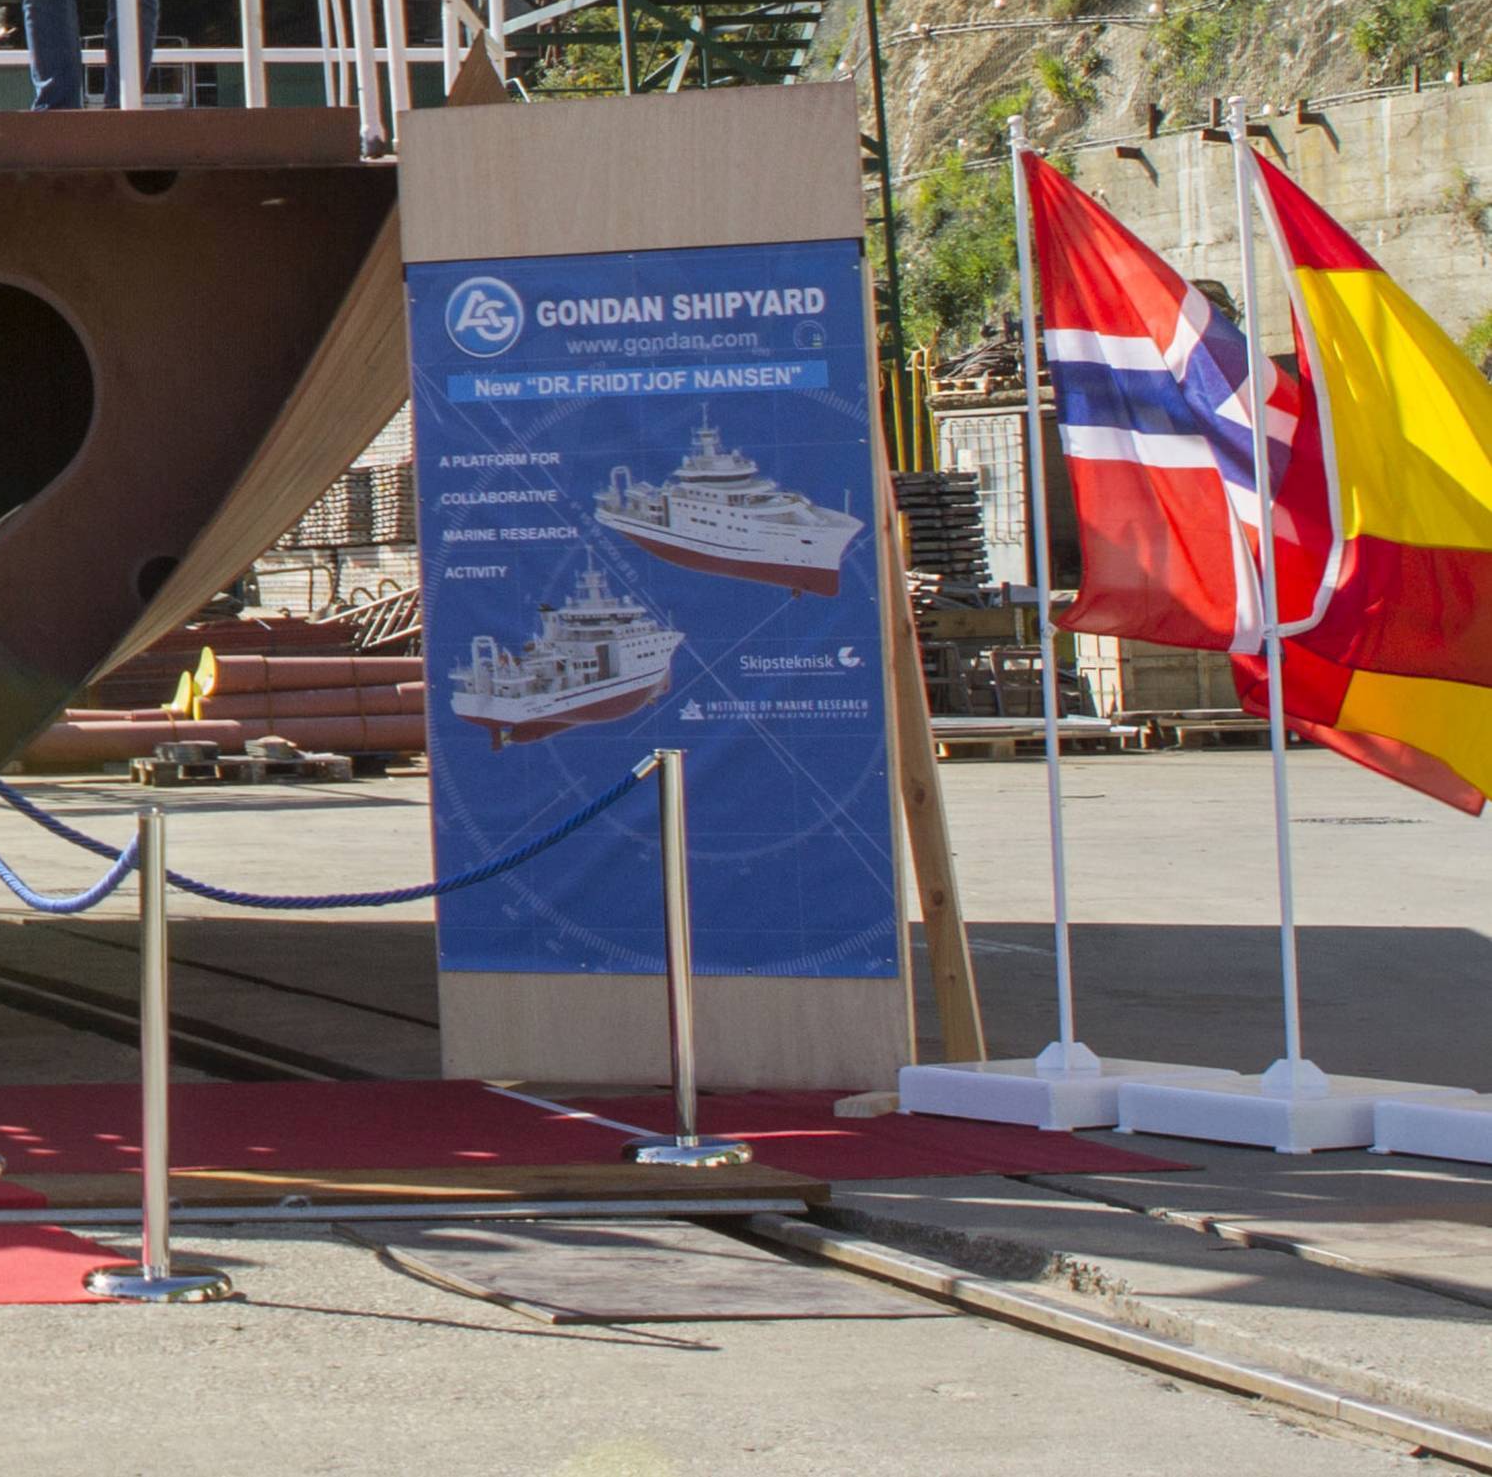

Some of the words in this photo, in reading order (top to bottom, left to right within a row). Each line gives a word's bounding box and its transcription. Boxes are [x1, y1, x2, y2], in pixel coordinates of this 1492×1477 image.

[536, 296, 664, 327] GONDAN
[673, 287, 825, 321] SHIPYARD
[566, 331, 758, 357] www.gondan.com
[475, 378, 520, 397] New
[439, 455, 451, 468] A
[452, 453, 527, 468] PLATFORM
[530, 452, 561, 466] FOR
[440, 489, 558, 505] COLLABORATIVE
[443, 528, 497, 542] MARINE
[500, 526, 579, 541] RESEARCH
[444, 565, 508, 579] ACTIVITY
[739, 654, 835, 672] Skipsteknisk
[706, 700, 756, 712] INSTITUTE
[759, 699, 772, 711] OF
[776, 699, 814, 711] MARINE
[818, 698, 868, 711] RESEARCH
